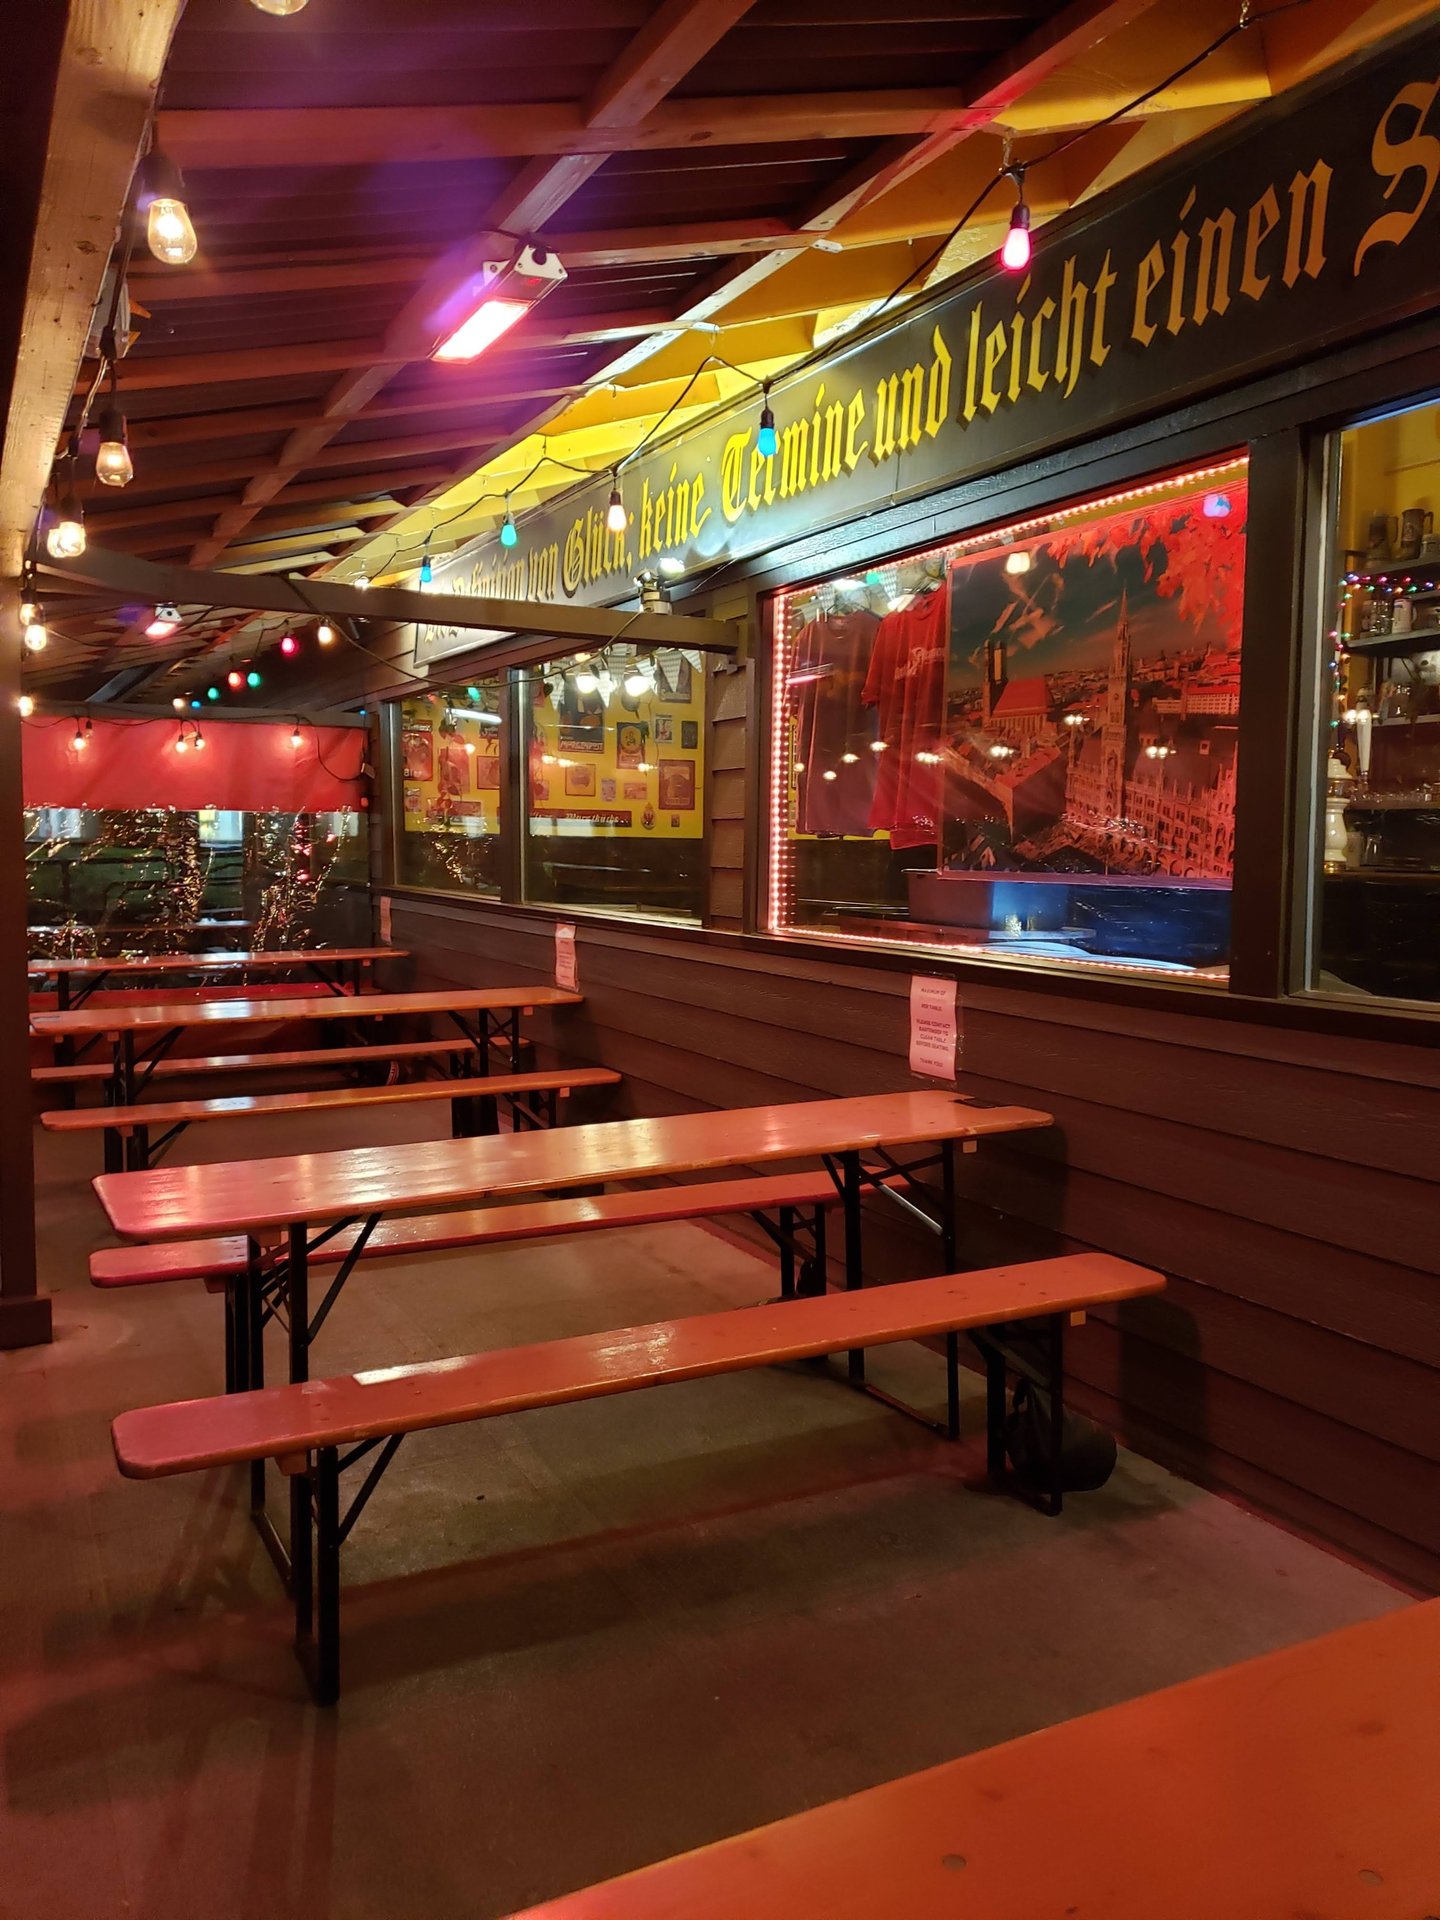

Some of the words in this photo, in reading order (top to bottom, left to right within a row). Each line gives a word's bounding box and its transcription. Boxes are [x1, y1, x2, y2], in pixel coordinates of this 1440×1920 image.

[639, 463, 712, 560] keine
[721, 383, 869, 522] Termine
[873, 324, 952, 461] und
[962, 248, 1118, 423] leicht
[1130, 158, 1334, 348] einen
